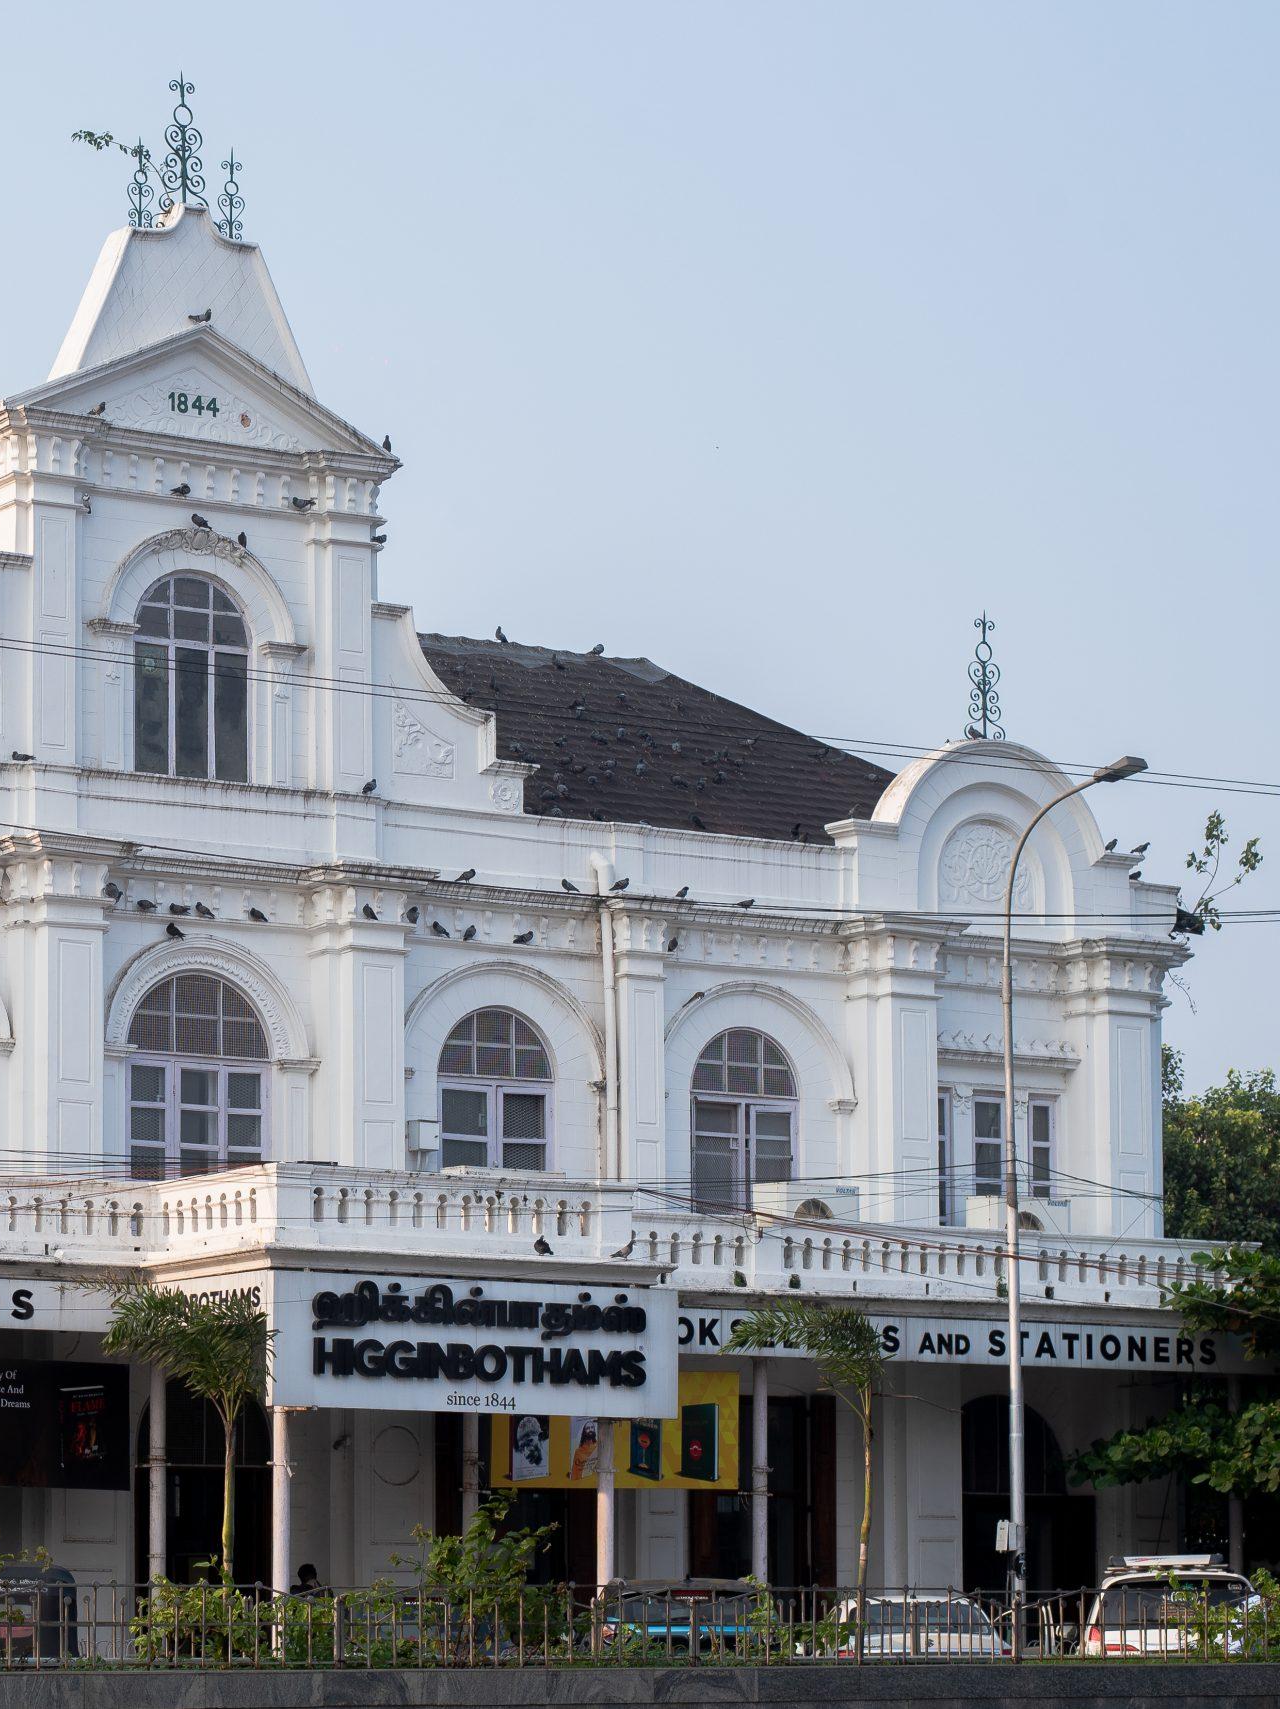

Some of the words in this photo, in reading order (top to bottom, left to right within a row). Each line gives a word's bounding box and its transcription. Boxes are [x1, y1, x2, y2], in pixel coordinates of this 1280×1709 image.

[168, 391, 220, 418] 1844
[918, 1331, 971, 1356] AND
[987, 1329, 1219, 1365] STATIONERS
[312, 1336, 647, 1387] HIGGINBOTHAMS
[5, 1369, 17, 1380] Of
[7, 1384, 24, 1394] And
[0, 1397, 31, 1409] Dreams
[446, 1391, 481, 1407] since
[484, 1393, 517, 1411] 1844
